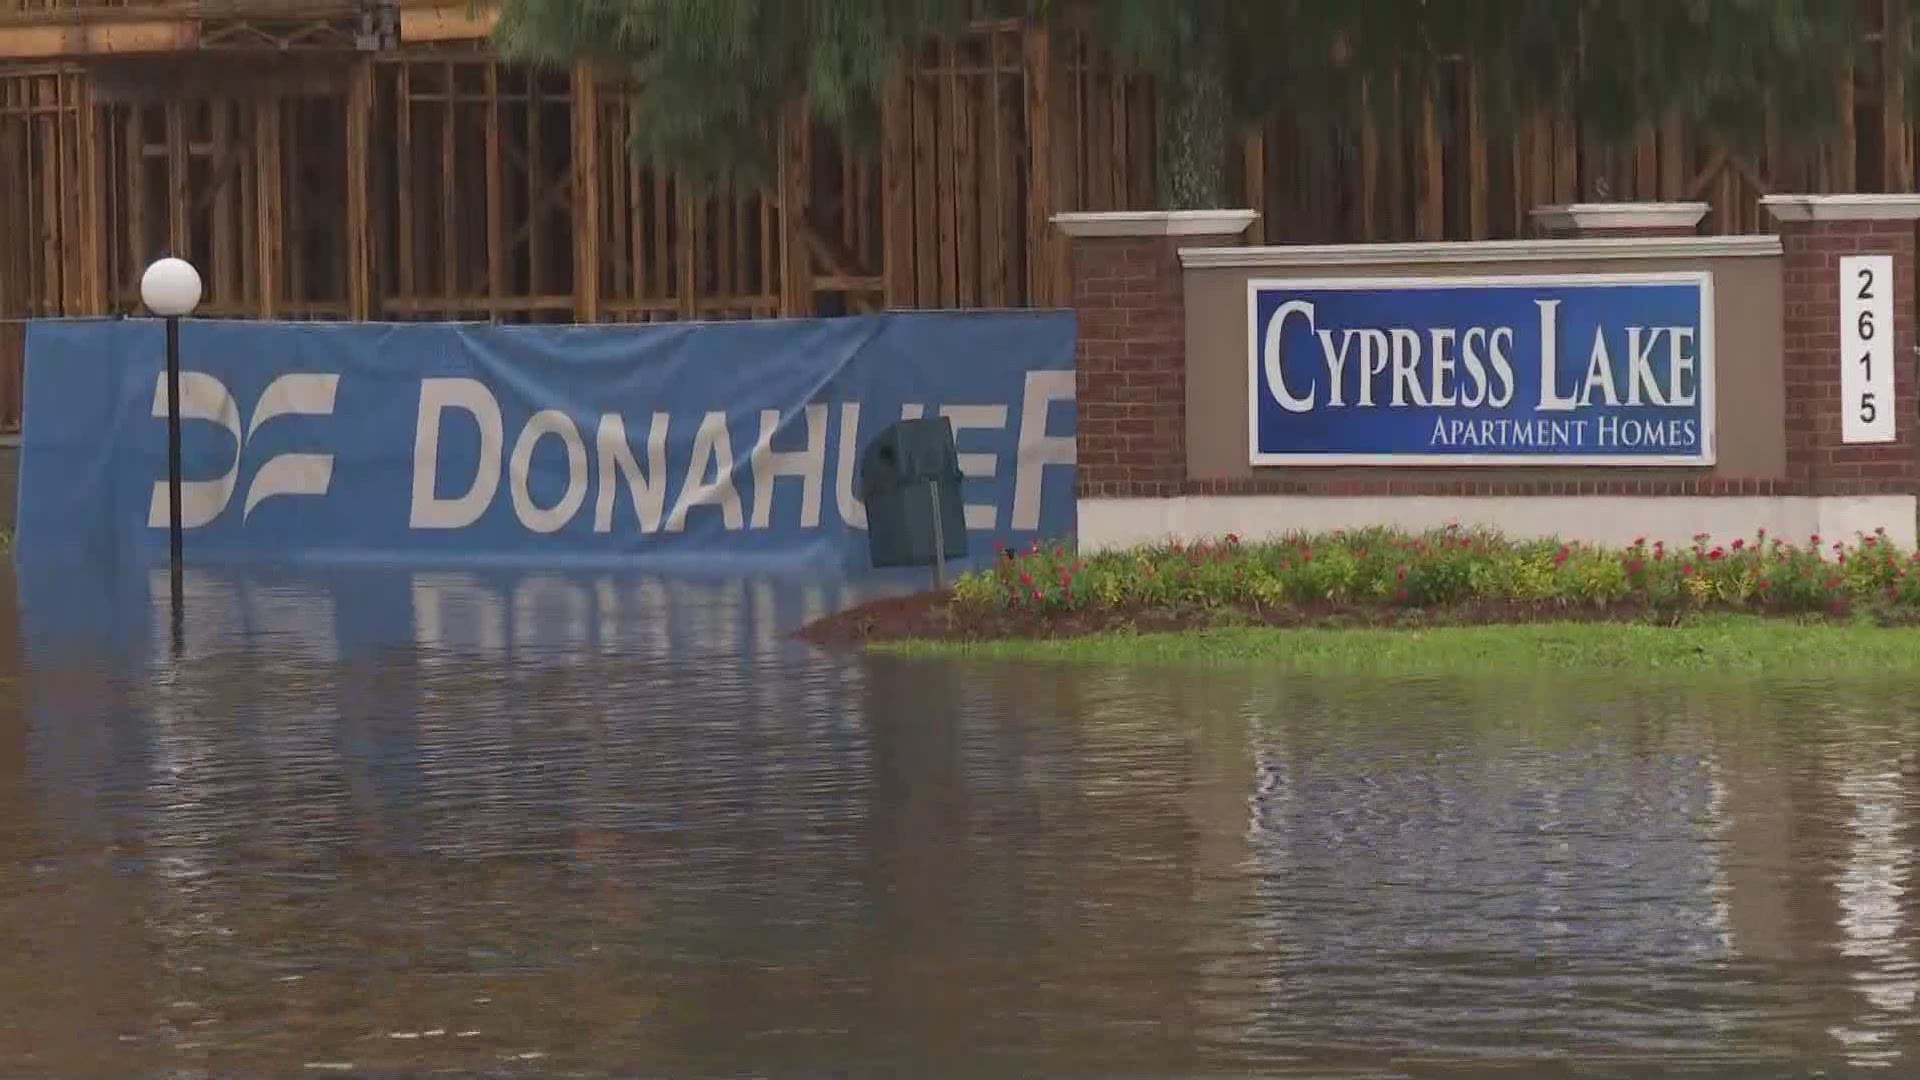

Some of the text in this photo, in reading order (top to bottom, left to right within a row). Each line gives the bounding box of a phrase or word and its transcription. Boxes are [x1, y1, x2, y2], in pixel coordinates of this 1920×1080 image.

[1264, 298, 1697, 413] CYPRESS LAKE
[1857, 269, 1876, 424] 2615
[1430, 415, 1697, 447] APARTMENT HOMES
